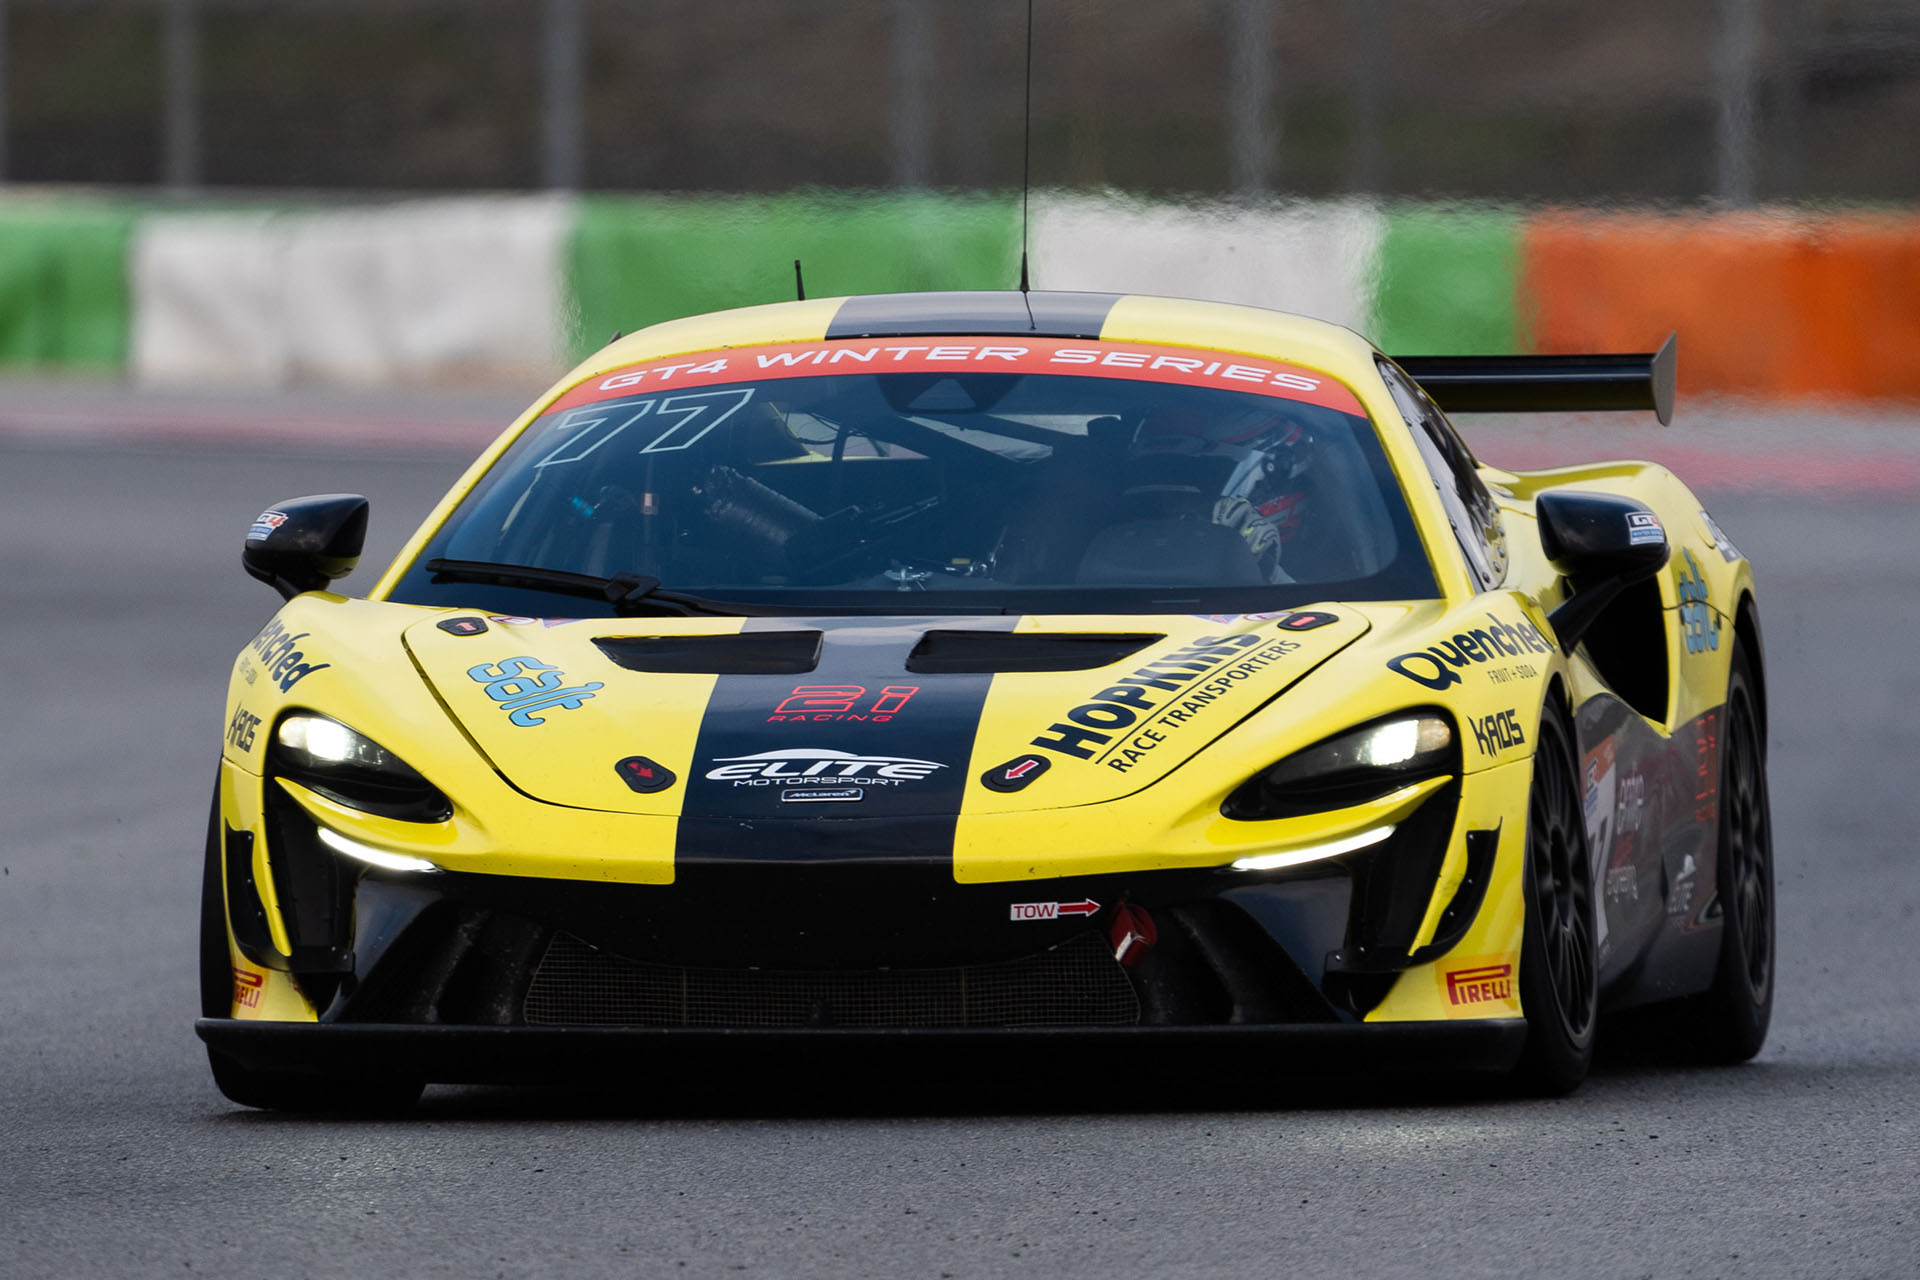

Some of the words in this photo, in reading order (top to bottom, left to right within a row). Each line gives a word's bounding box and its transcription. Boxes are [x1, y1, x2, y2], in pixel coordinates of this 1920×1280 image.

[599, 358, 729, 391] GT4
[757, 346, 1029, 367] WINTER
[1049, 349, 1321, 391] SERIES
[535, 388, 755, 468] 77
[767, 714, 893, 723] RACING
[1030, 634, 1262, 761] HOPKINS
[1108, 727, 1167, 773] RACE
[1158, 639, 1301, 729] TRANSPORTERS
[1467, 709, 1525, 758] KAOS
[705, 760, 940, 780] ELITE
[733, 776, 905, 787] MOTORSPORT
[1013, 903, 1056, 919] TOW
[1446, 964, 1511, 1006] PIRELLI
